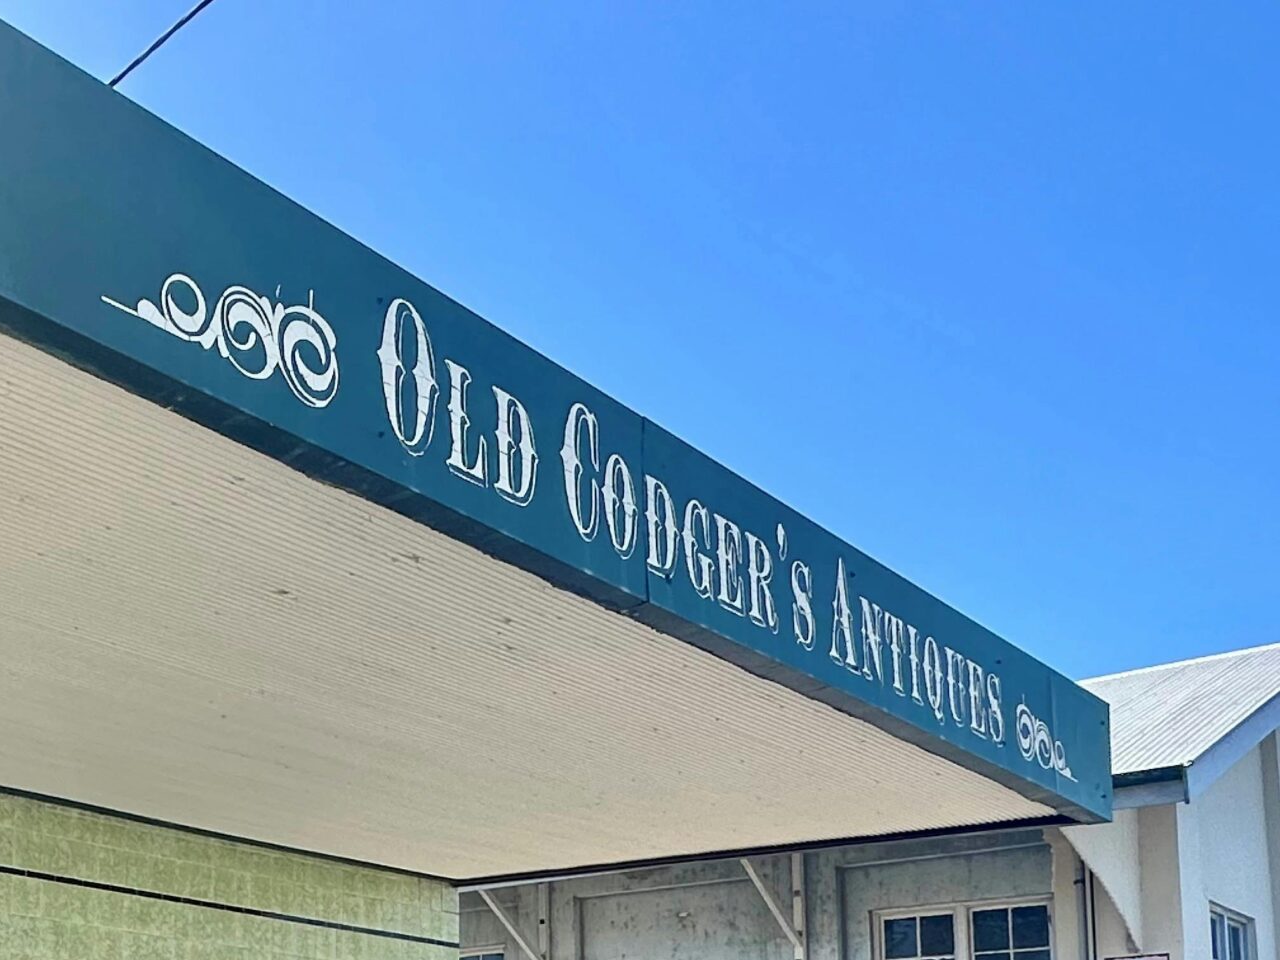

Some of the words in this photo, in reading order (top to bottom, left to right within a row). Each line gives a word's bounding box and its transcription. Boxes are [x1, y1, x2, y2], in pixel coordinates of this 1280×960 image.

[377, 298, 538, 507] OLD
[561, 402, 815, 651] CODGER'S
[829, 556, 1006, 747] ANTIQUES
